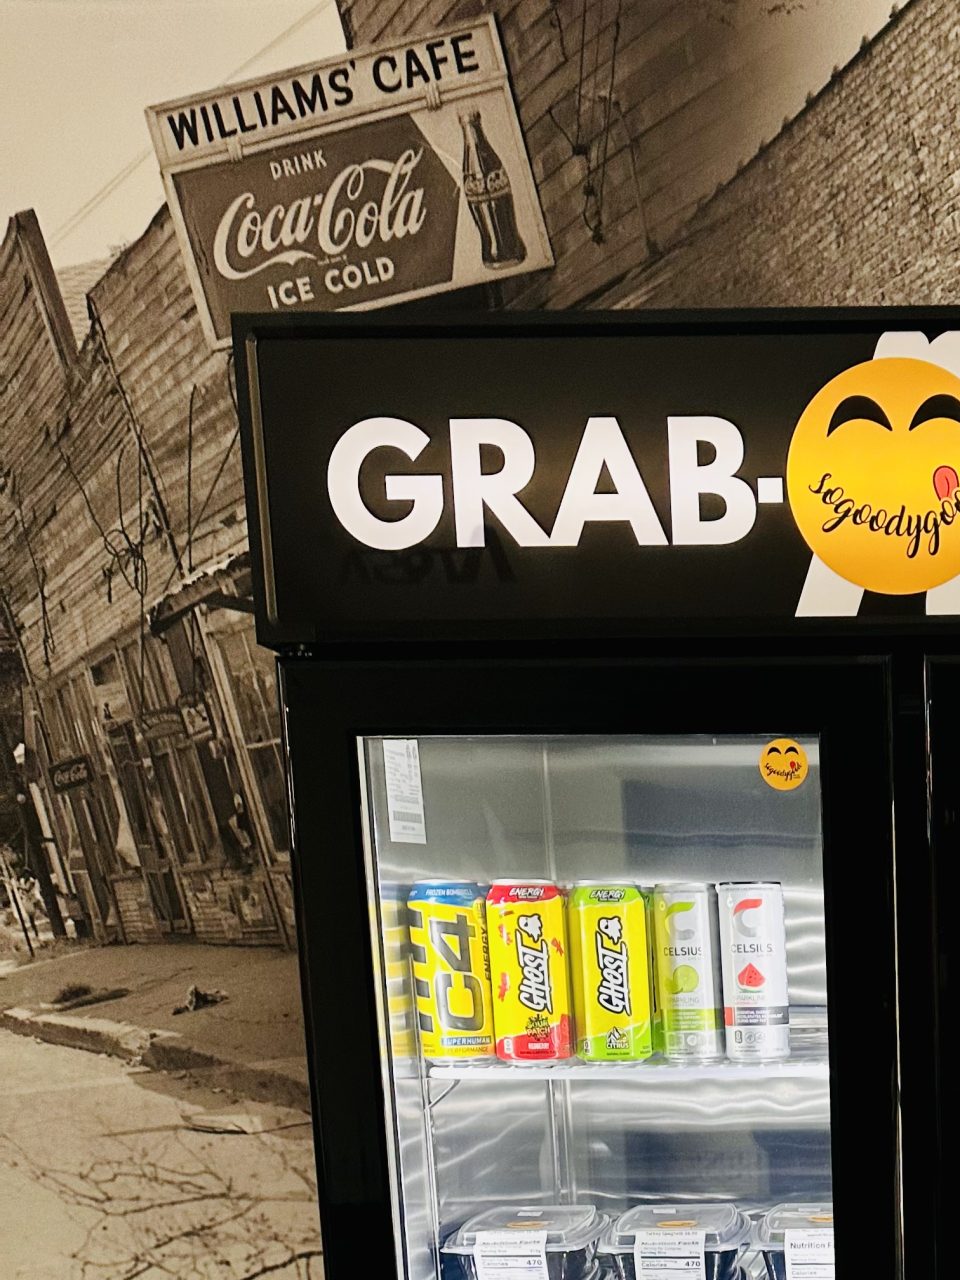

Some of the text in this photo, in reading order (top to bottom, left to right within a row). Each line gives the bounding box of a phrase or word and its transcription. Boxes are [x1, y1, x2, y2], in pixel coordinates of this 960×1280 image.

[167, 33, 480, 151] WILLIAMS' CAFE
[270, 150, 327, 180] DRINK
[213, 145, 427, 280] Coca-Cola
[267, 257, 395, 309] ICE COLD
[509, 888, 544, 897] ENERGY
[590, 890, 625, 899] ENERGY
[429, 914, 484, 1032] C4
[516, 929, 553, 1014] GHOST
[596, 932, 632, 1016] GHOST
[664, 947, 702, 956] CELSIUS
